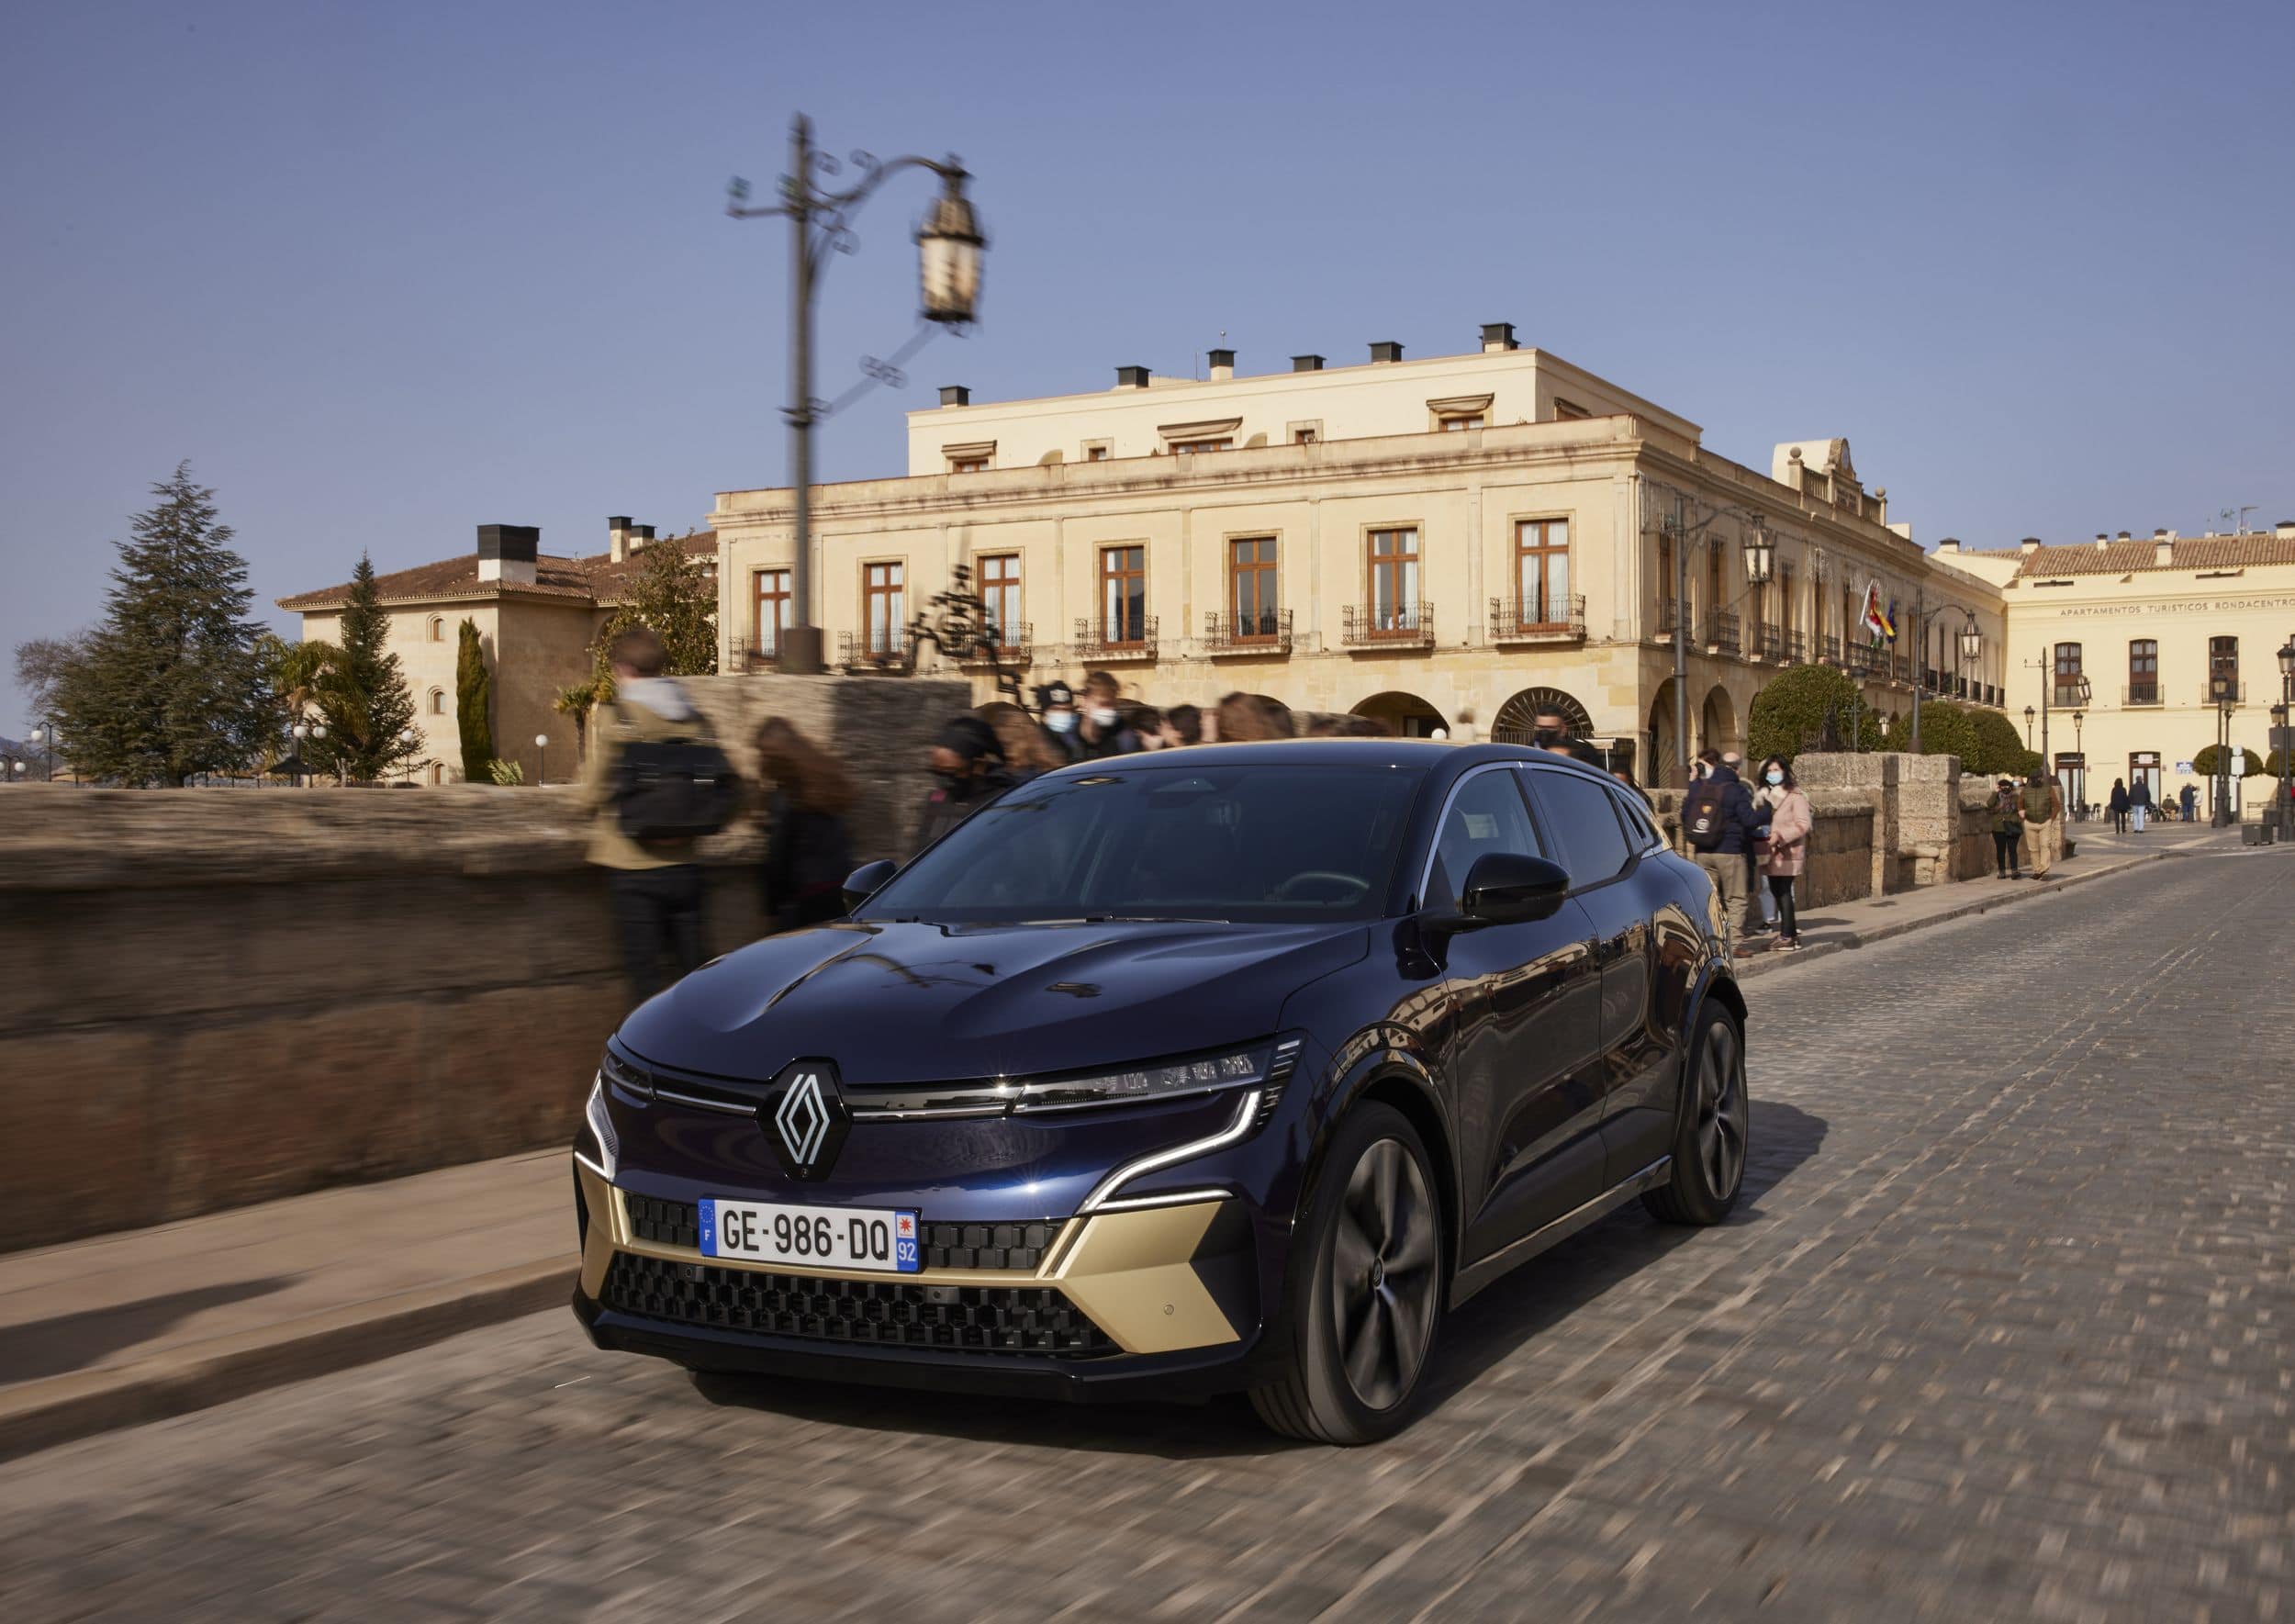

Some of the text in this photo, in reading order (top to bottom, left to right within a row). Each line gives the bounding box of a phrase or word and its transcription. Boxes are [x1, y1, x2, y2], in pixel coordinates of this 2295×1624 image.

[2060, 606, 2142, 617] APARTAMENTOS
[2147, 602, 2209, 613] TURISTICOS
[704, 1229, 711, 1241] F
[723, 1210, 890, 1260] GE-986-DQ
[898, 1242, 916, 1262] 92
